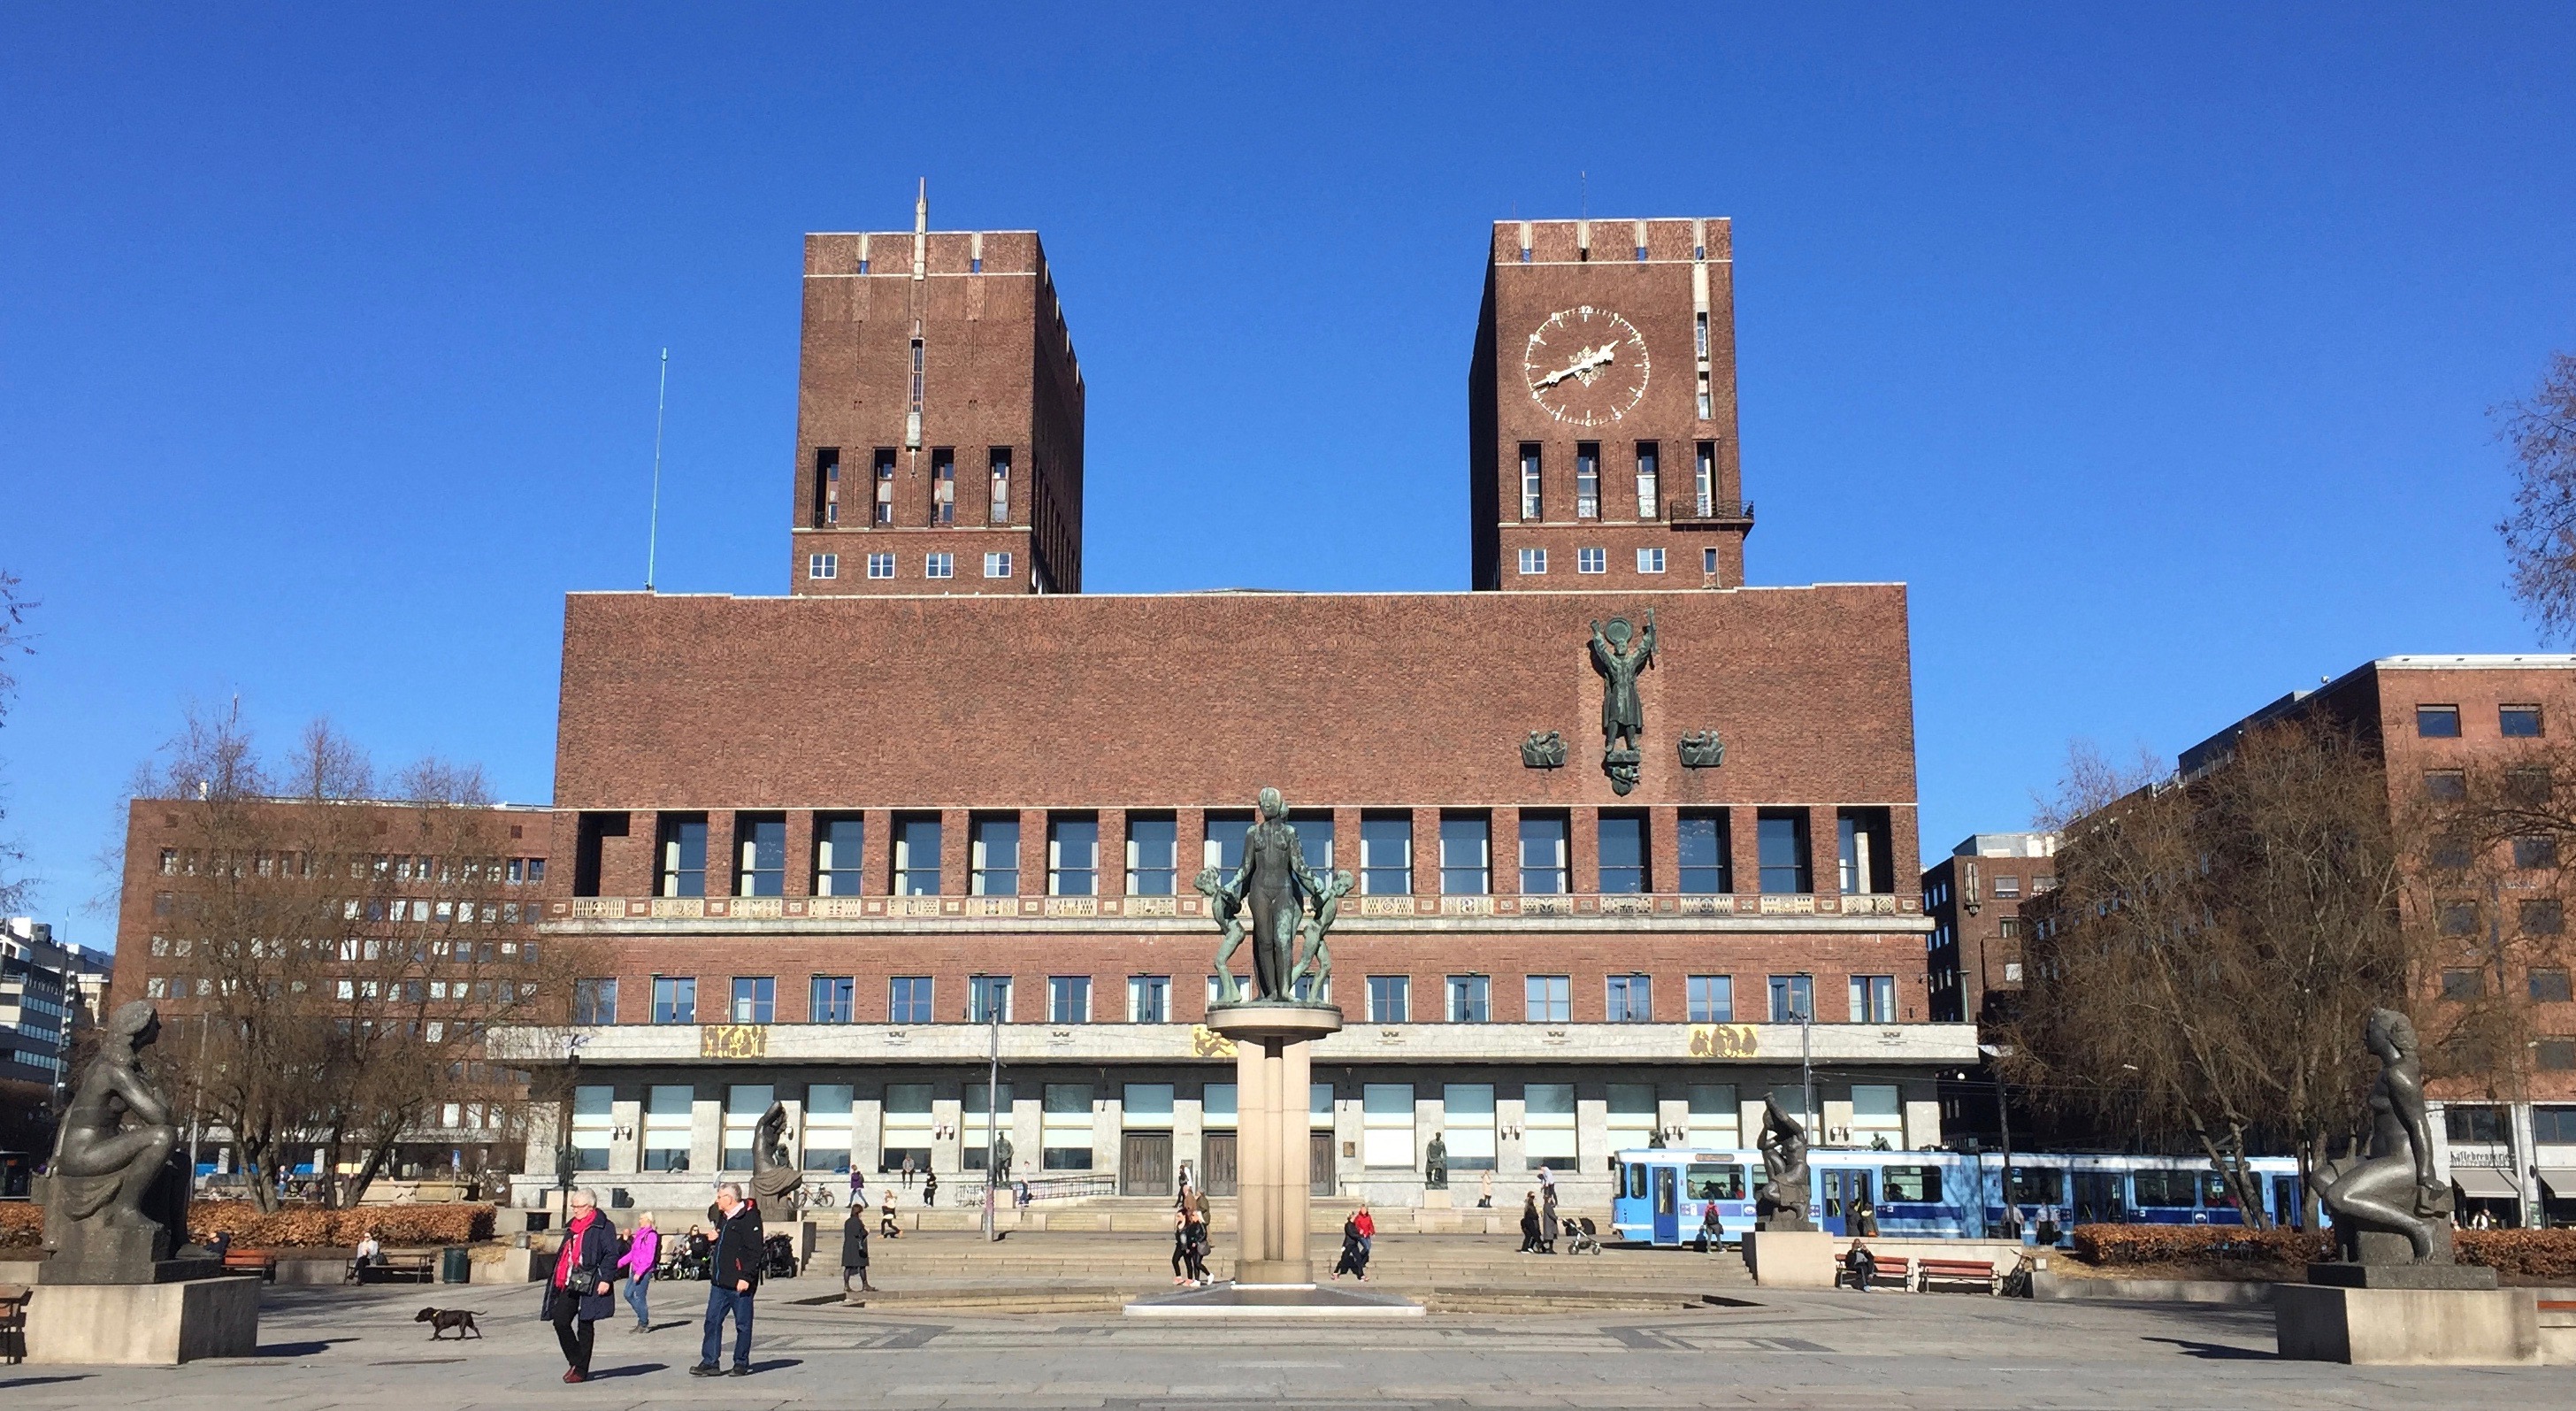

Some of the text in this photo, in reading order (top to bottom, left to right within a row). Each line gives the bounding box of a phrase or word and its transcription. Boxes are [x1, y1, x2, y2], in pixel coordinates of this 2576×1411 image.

[1581, 305, 1593, 314] 12
[1551, 312, 1560, 321] 11
[1614, 312, 1619, 321] 1
[1530, 334, 1541, 342] 10
[1635, 333, 1643, 341] 2
[1644, 361, 1651, 370] 3
[1554, 411, 1561, 421] 7
[1614, 410, 1622, 420] 5
[1584, 418, 1592, 427] 6
